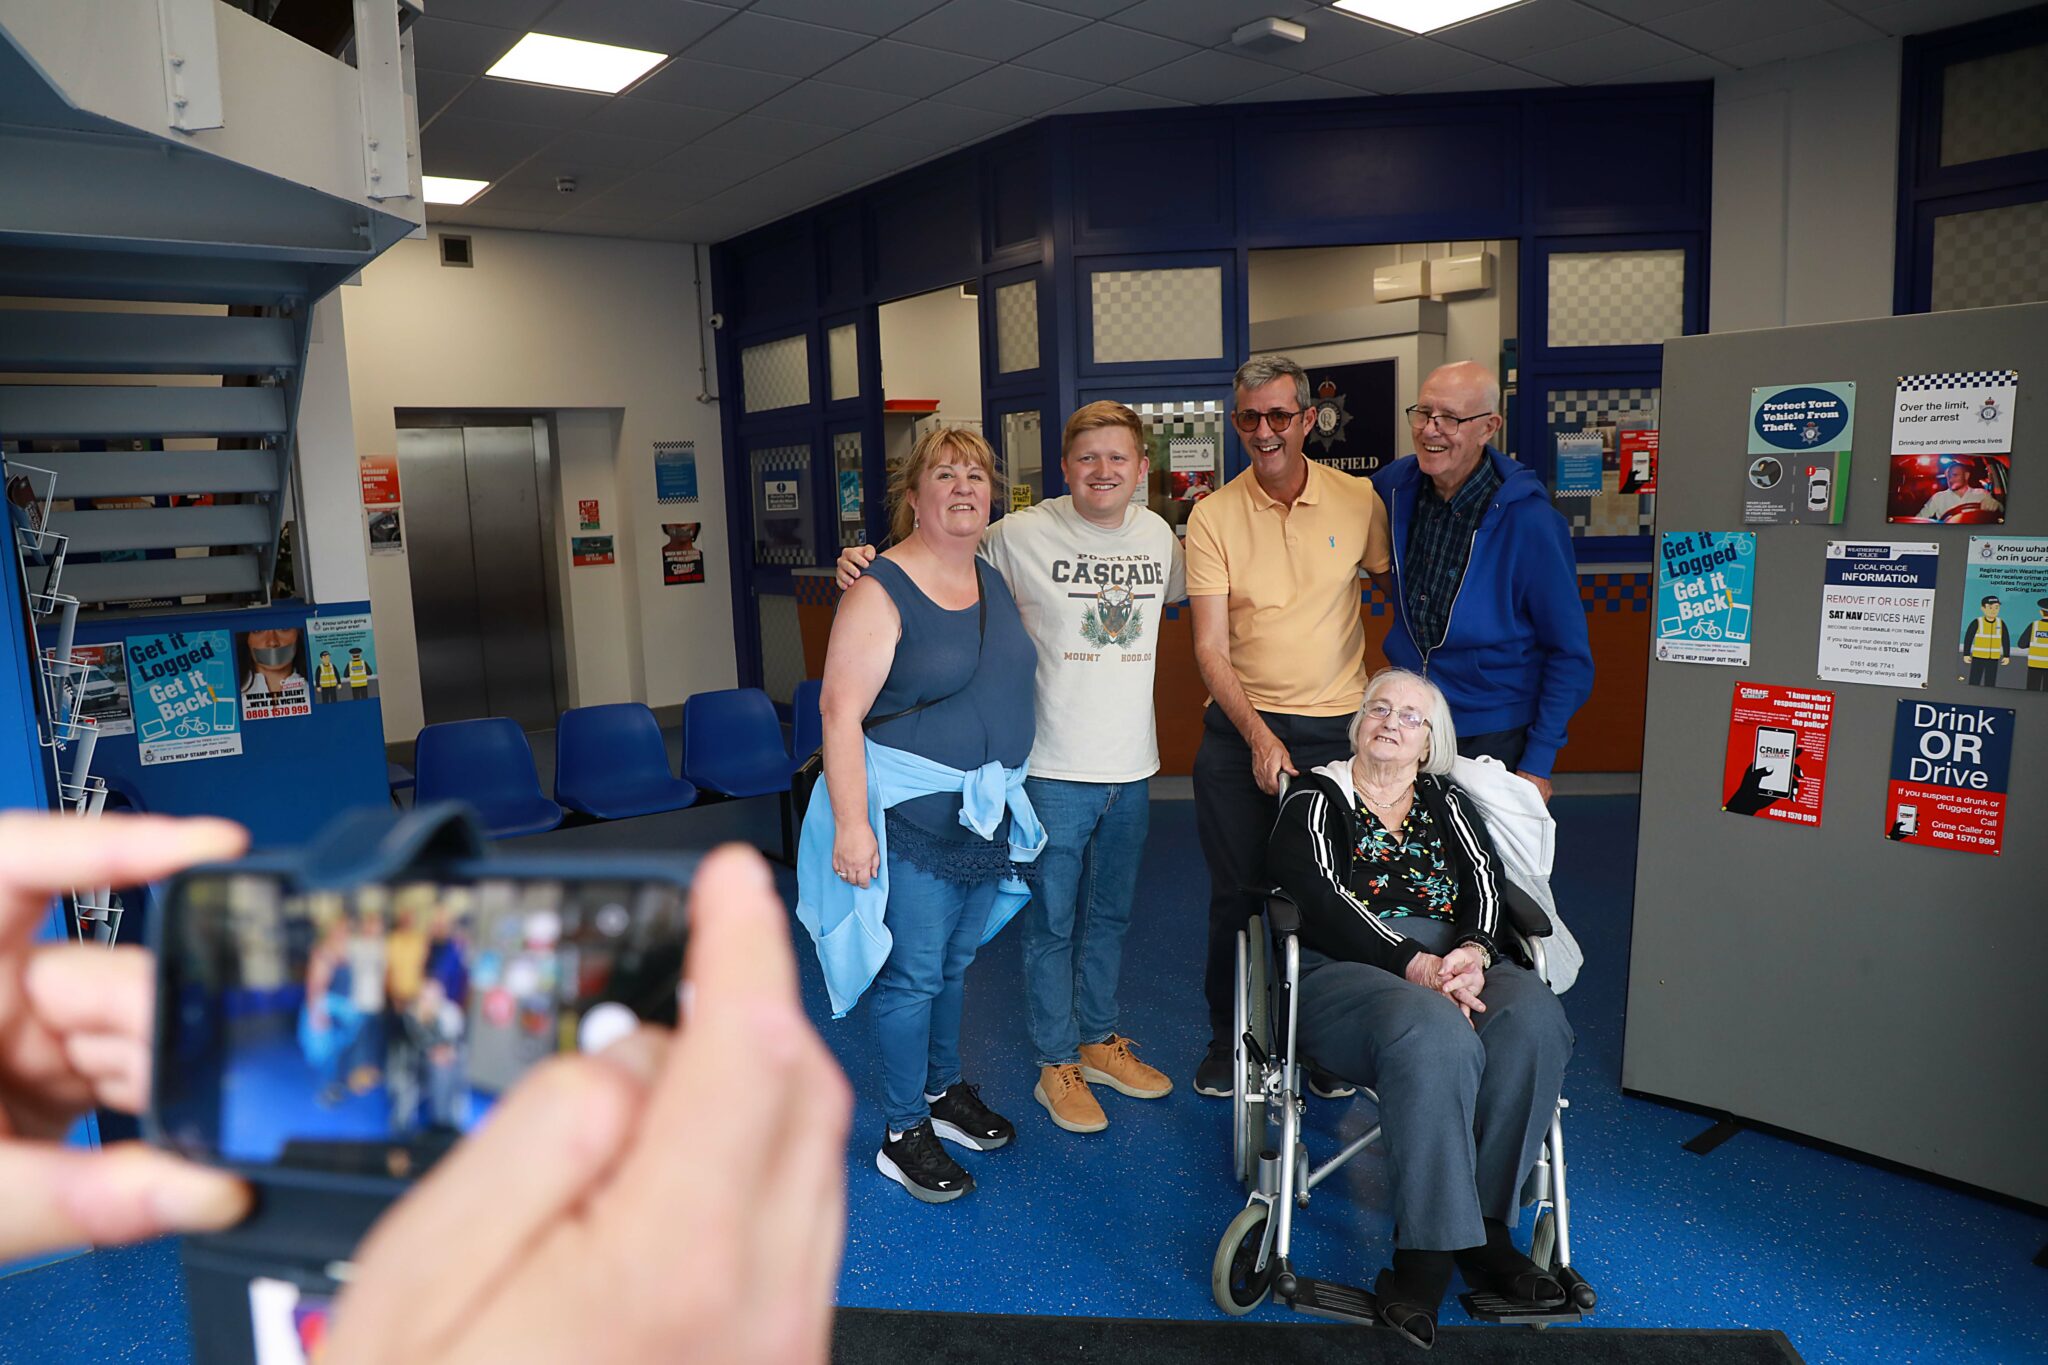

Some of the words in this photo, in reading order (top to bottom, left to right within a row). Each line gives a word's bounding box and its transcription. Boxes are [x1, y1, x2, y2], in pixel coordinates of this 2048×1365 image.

[1763, 401, 1806, 411] Protect
[1808, 400, 1837, 409] Your
[1900, 403, 1924, 411] Over
[1944, 401, 1969, 410] limit,
[1763, 412, 1805, 421] Vehicle
[1806, 411, 1839, 419] From
[1899, 414, 1928, 422] under
[1930, 413, 1960, 422] arrest
[1762, 423, 1797, 432] Theft.
[1939, 438, 1961, 446] driving
[1663, 536, 1695, 560] Get
[1698, 532, 1714, 549] it
[1998, 544, 2024, 552] Know
[1667, 543, 1737, 578] Logged
[1052, 560, 1164, 585] CASCADE
[1842, 573, 1918, 583] INFORMATION
[1674, 577, 1707, 601] Get
[1710, 572, 1726, 591] it
[1679, 589, 1734, 620] Back!
[1826, 594, 1864, 604] REMOVE
[1867, 596, 1876, 605] IT
[1878, 597, 1892, 606] OR
[1894, 598, 1919, 607] LOSE
[1922, 599, 1931, 608] IT
[1829, 610, 1844, 619] SAT
[1846, 611, 1862, 620] NAV
[1863, 612, 1900, 622] DEVICES
[1902, 614, 1925, 624] HAVE
[130, 639, 167, 665] Get
[169, 632, 188, 650] it
[138, 641, 215, 682] Logged
[1064, 652, 1100, 662] MOUNT
[1840, 667, 1873, 676] emergency
[149, 678, 187, 704] Get
[188, 670, 208, 689] it
[1740, 687, 1769, 698] CRIME
[158, 685, 218, 722] Back!
[280, 697, 306, 705] VICTIMS
[1792, 692, 1810, 700] know
[1812, 694, 1832, 702] who's
[246, 709, 269, 719] 0808
[271, 707, 290, 716] 1570
[292, 705, 308, 714] 999
[1774, 700, 1814, 710] responsible
[1915, 704, 1995, 734] Drink
[1759, 746, 1790, 757] CRIME
[1920, 730, 1982, 764] OR
[1910, 758, 1988, 789] Drive
[1905, 789, 1920, 797] you
[1922, 792, 1954, 802] suspect
[1964, 797, 1988, 806] drunk
[1937, 803, 1972, 814] drugged
[1974, 808, 1998, 817] driver
[1932, 821, 1956, 830] Crime
[1958, 824, 1982, 833] Caller
[1980, 818, 1997, 827] Call
[1933, 831, 1954, 840] 0808
[1956, 834, 1976, 842] 1570
[1979, 837, 1995, 845] 999
